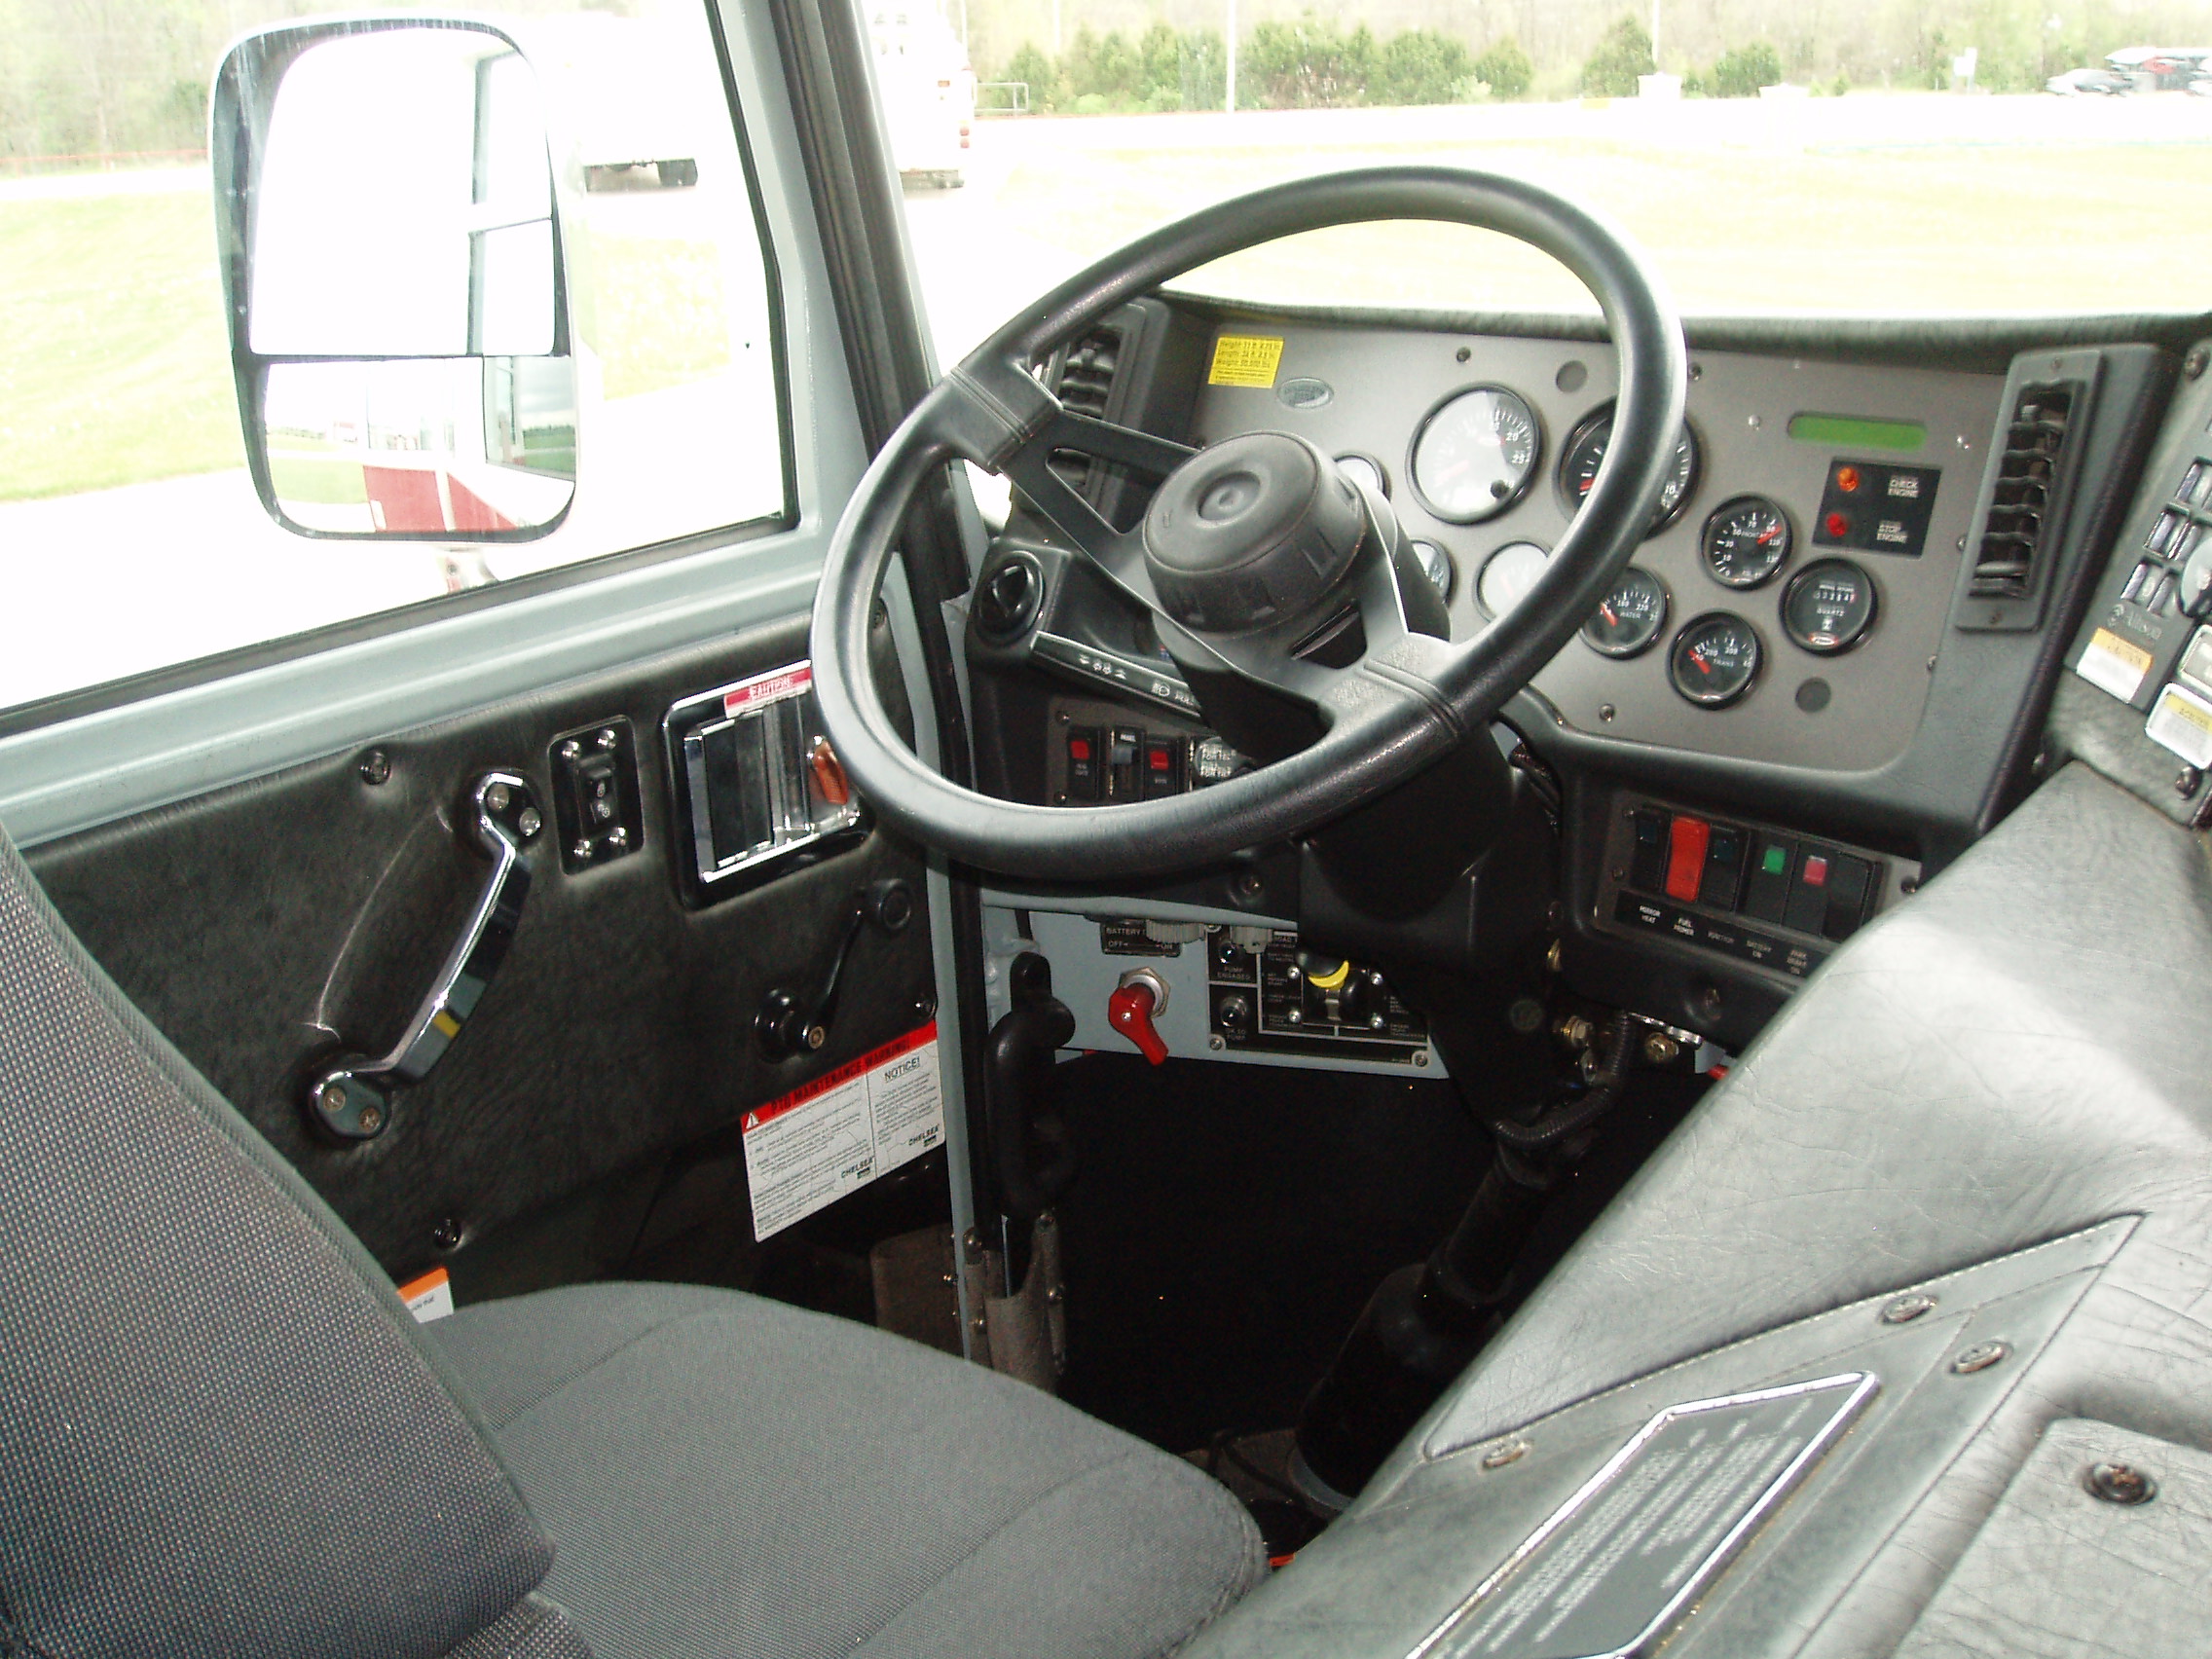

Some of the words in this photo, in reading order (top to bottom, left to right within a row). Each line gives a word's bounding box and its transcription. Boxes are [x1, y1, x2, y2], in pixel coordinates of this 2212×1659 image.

[1506, 432, 1519, 441] 20
[1512, 453, 1525, 464] 25
[1888, 488, 1919, 498] ENGINE
[1877, 533, 1908, 544] ENGINE
[1106, 927, 1141, 936] BATTERY
[884, 1055, 921, 1082] NOTICE!
[793, 1061, 863, 1098] MAINTENANCE
[908, 1124, 939, 1146] CHELSEA
